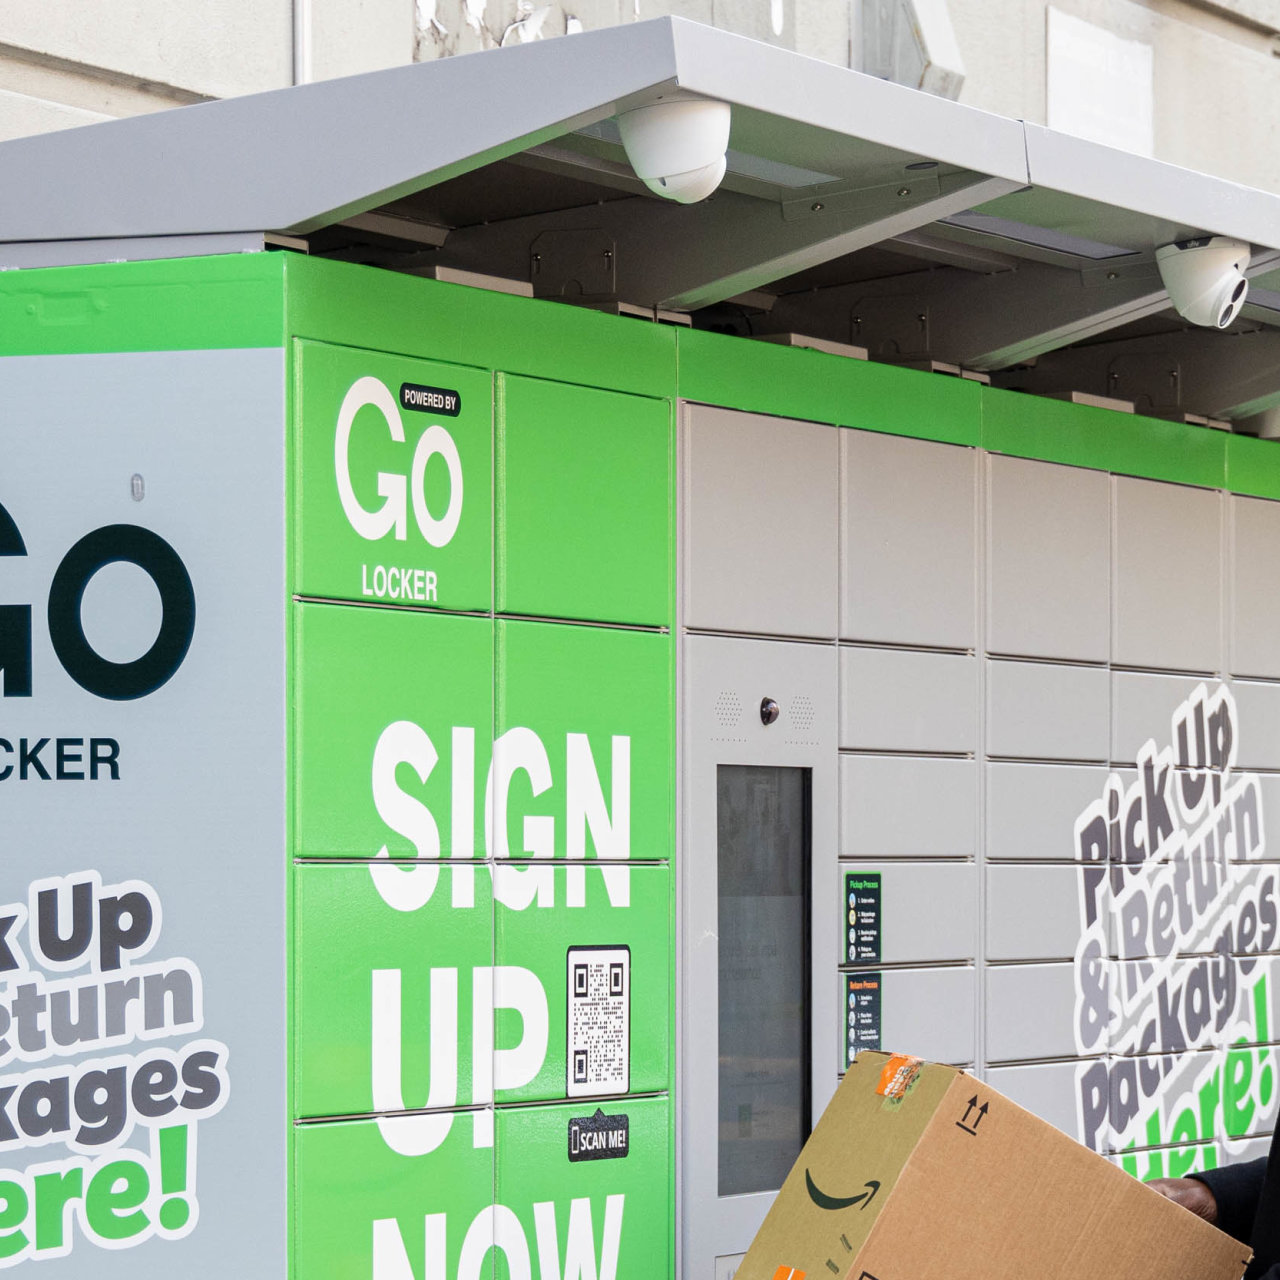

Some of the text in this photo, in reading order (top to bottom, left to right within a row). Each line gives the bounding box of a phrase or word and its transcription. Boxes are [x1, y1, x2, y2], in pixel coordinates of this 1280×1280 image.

[335, 376, 463, 548] Go
[405, 389, 457, 410] POWERED BY
[362, 563, 438, 601] LOCKER
[369, 720, 631, 912] SIGN
[1080, 699, 1233, 930] Pick Up
[37, 881, 152, 972] Up
[1080, 782, 1259, 1049] & Return
[372, 965, 549, 1157] UP
[1081, 875, 1277, 1151] Packages
[580, 1129, 626, 1151] SCAN ME!
